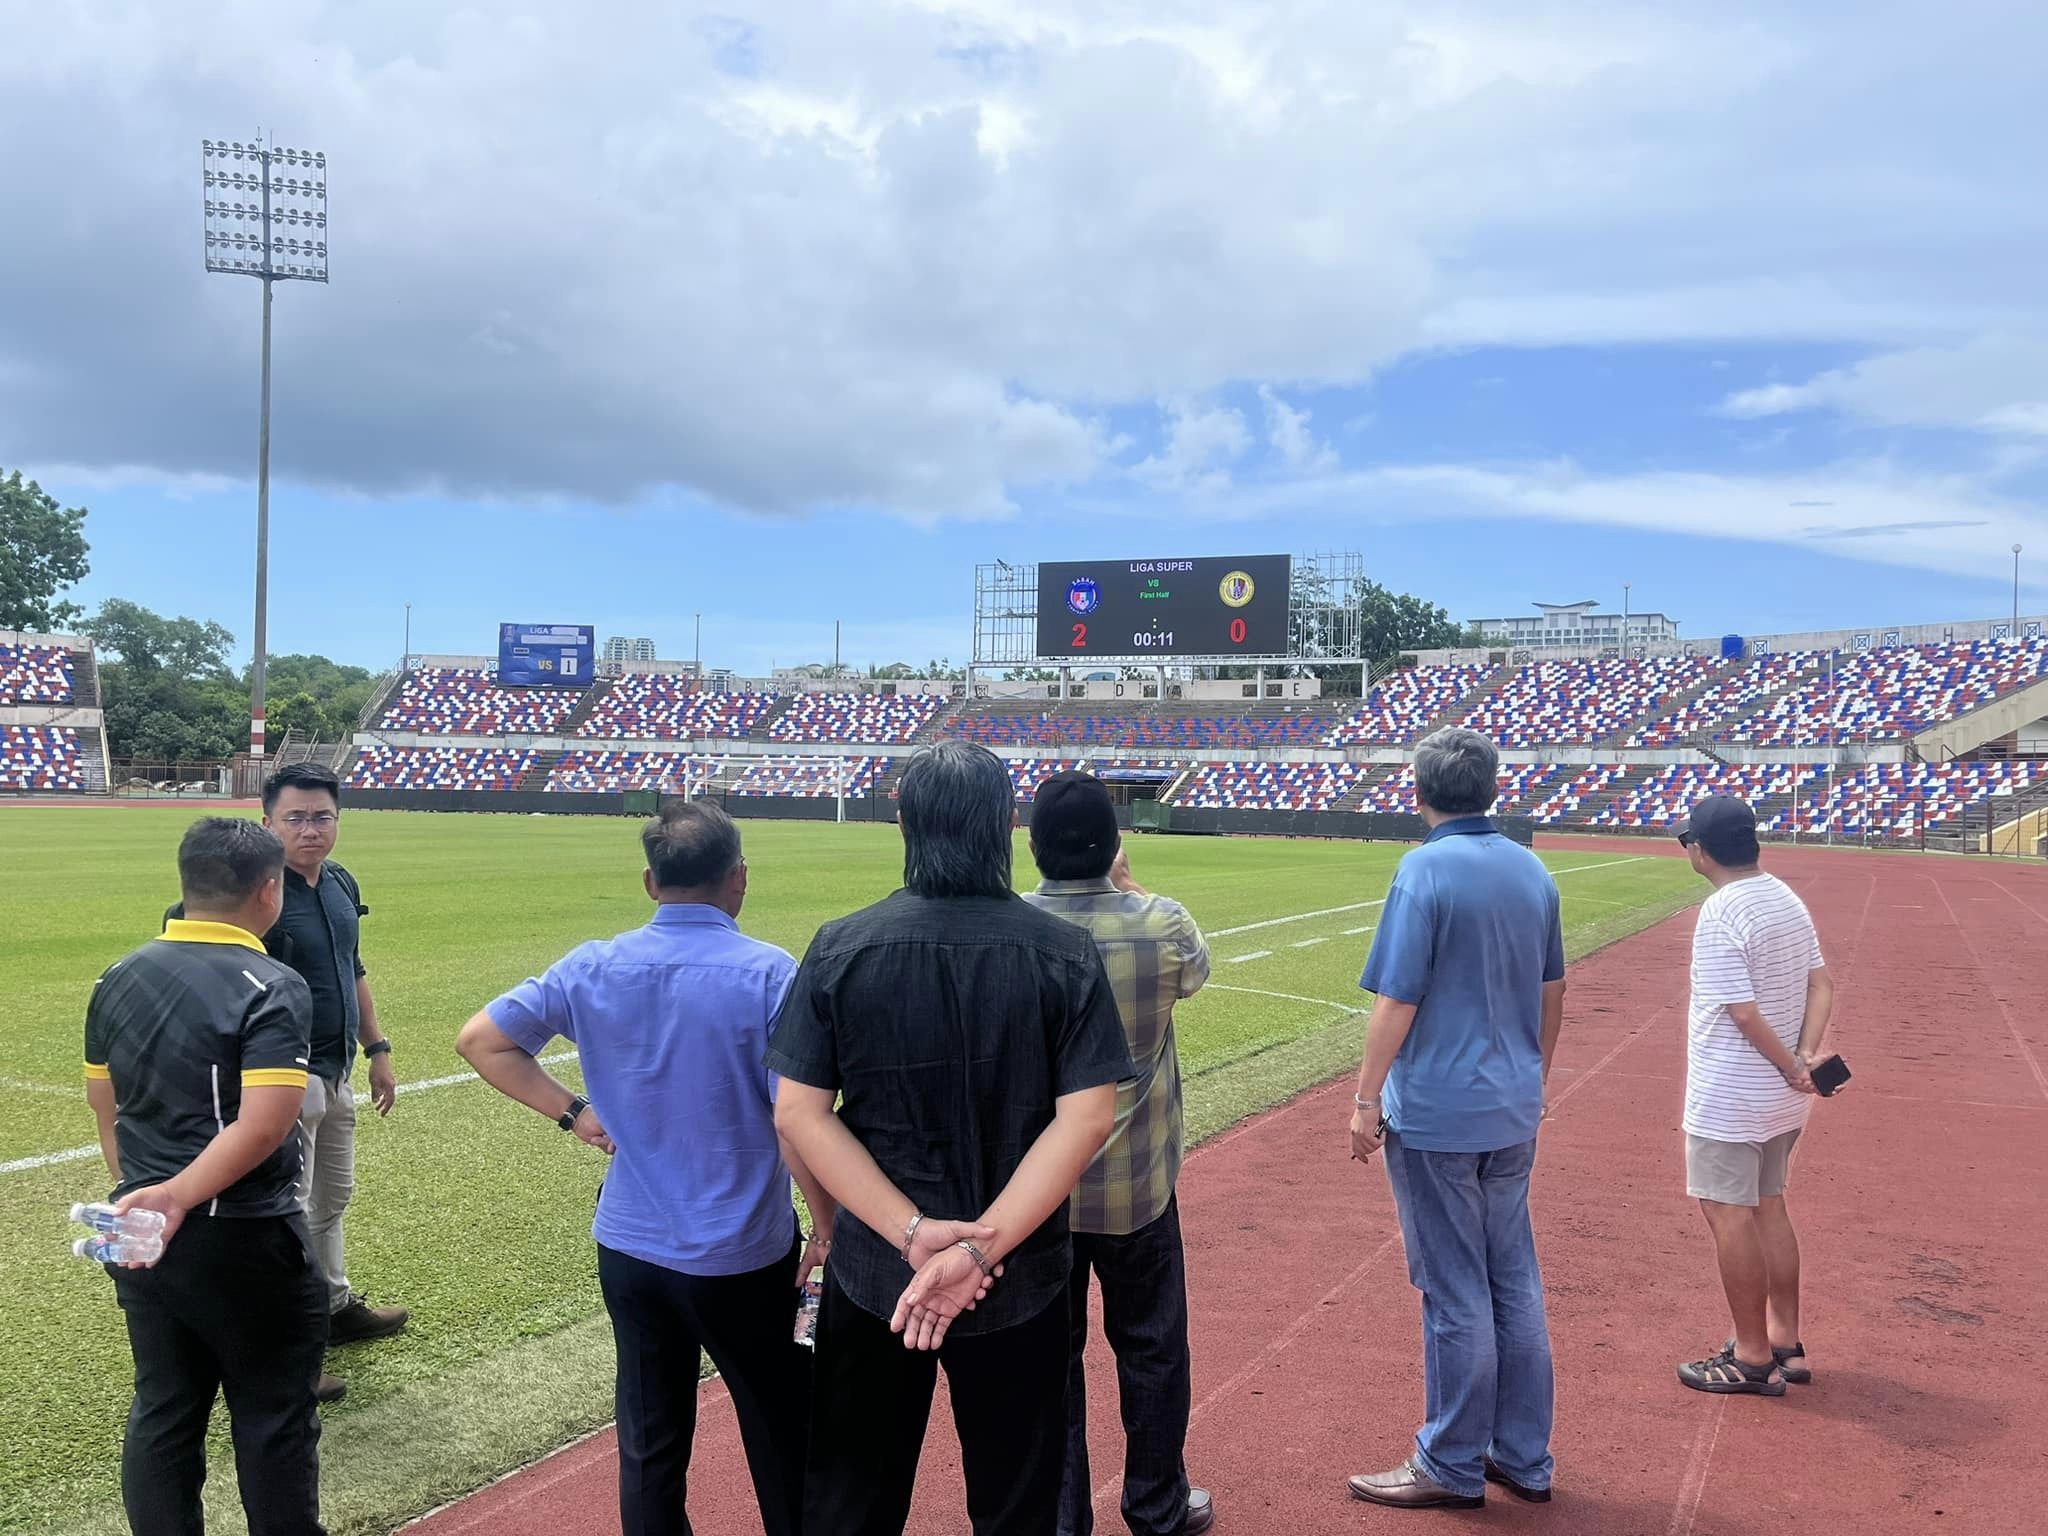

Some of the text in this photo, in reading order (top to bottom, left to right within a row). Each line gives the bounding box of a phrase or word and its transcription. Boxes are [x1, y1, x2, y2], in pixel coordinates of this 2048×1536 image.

[1130, 561, 1193, 572] LIGA SUPER
[1147, 579, 1160, 587] VS
[1072, 623, 1087, 647] 2
[1230, 618, 1246, 642] 0
[1133, 632, 1173, 646] 00:11
[1943, 627, 1953, 642] H
[538, 660, 552, 670] VS
[922, 683, 930, 696] C
[1116, 684, 1124, 697] D
[1293, 682, 1300, 697] E
